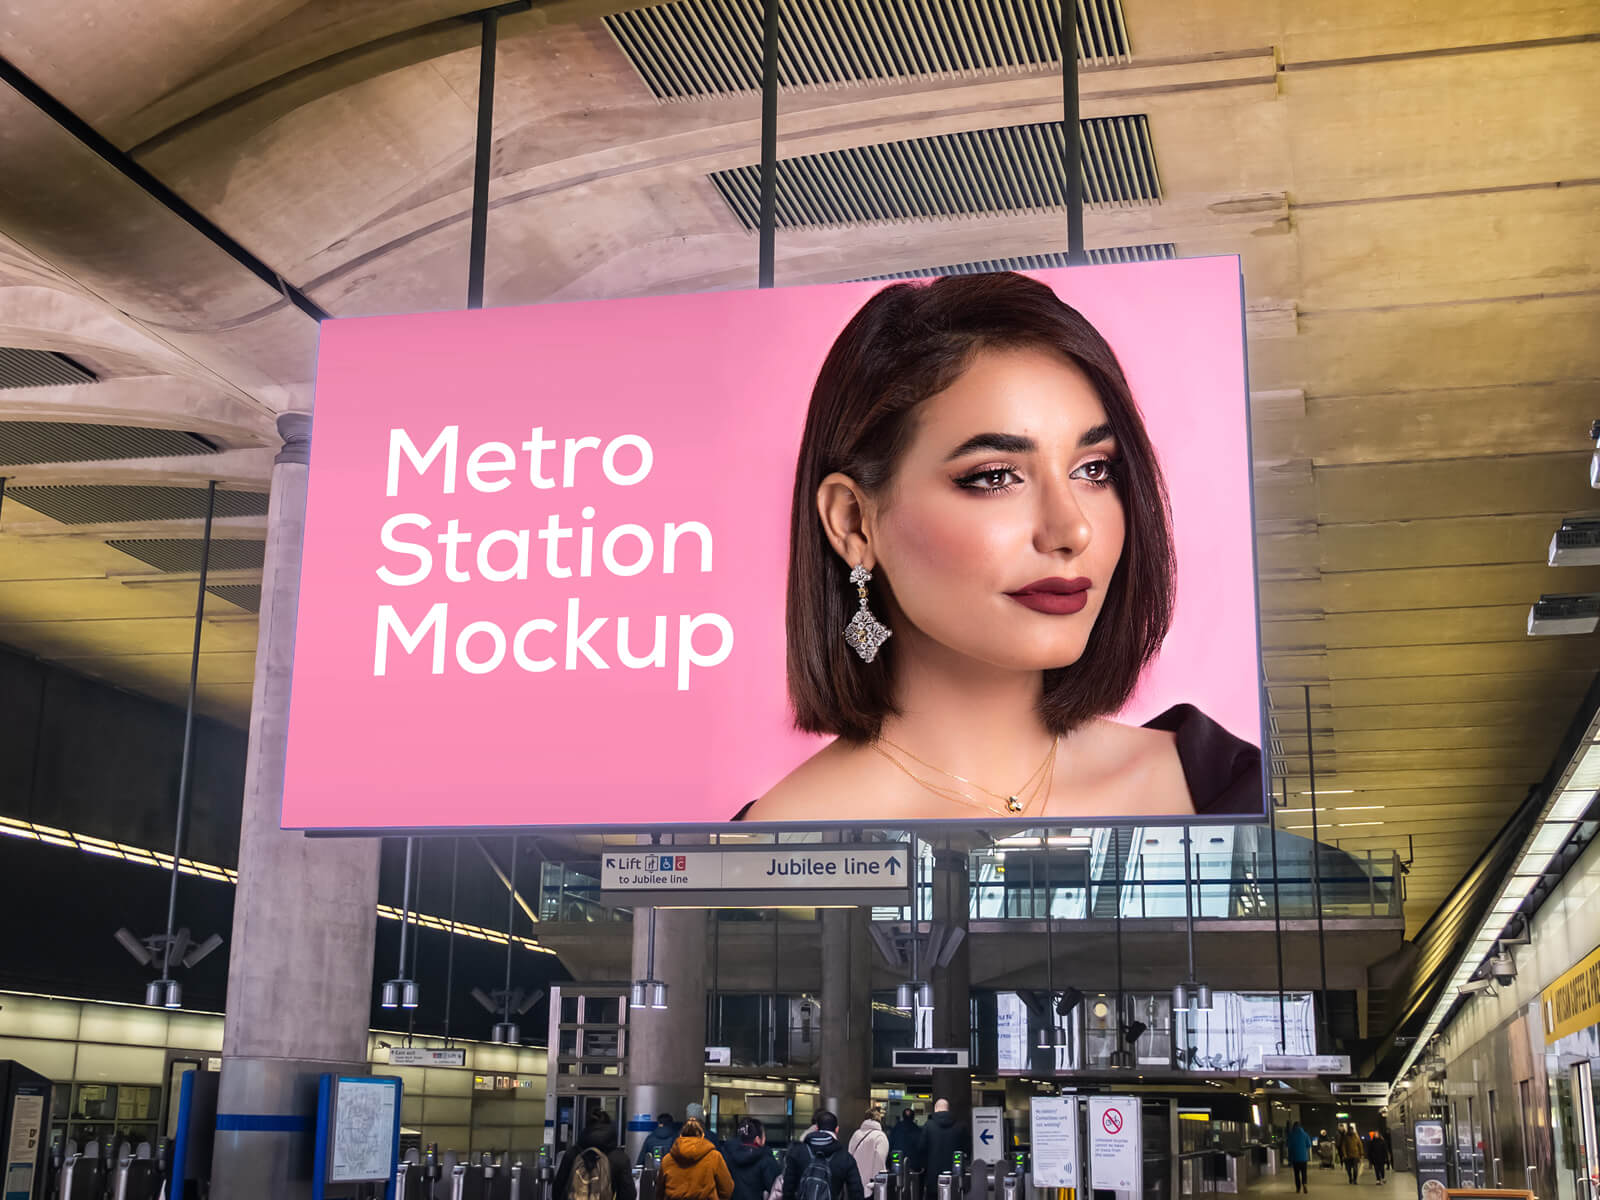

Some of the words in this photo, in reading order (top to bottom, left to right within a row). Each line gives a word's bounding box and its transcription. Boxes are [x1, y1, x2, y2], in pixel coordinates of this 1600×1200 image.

[386, 425, 654, 497] Metro
[375, 506, 713, 586] Station
[374, 597, 735, 691] Mockup
[618, 856, 641, 870] Lift
[618, 875, 630, 884] to
[631, 874, 669, 884] Jubilee
[670, 874, 688, 884] line
[766, 858, 837, 876] Jubilee
[844, 857, 880, 874] line
